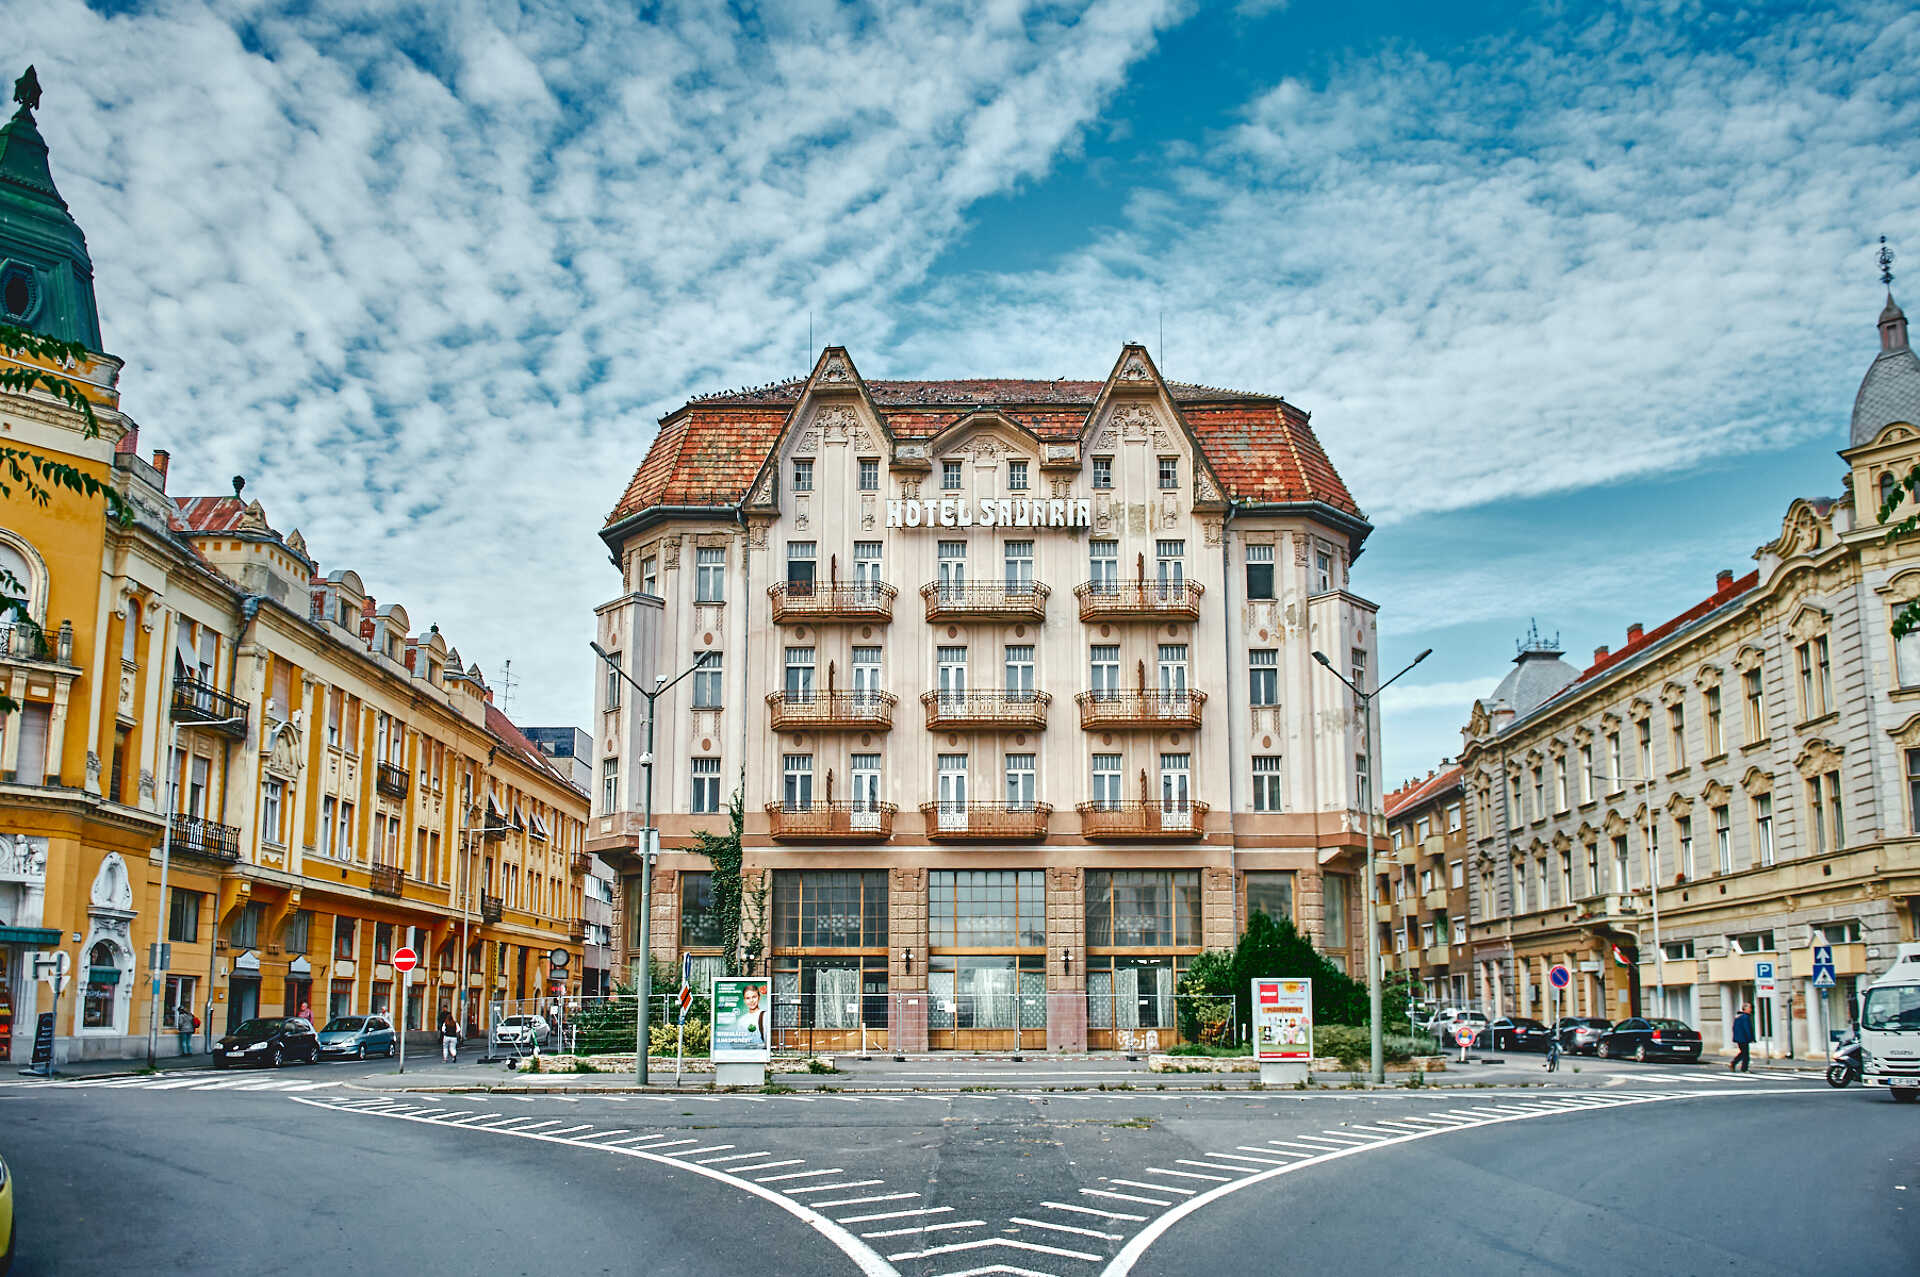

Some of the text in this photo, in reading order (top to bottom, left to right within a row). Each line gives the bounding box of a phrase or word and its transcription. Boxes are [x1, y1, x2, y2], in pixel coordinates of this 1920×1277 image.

[885, 498, 1092, 528] HOTEL SAVARIA
[1760, 965, 1770, 977] P
